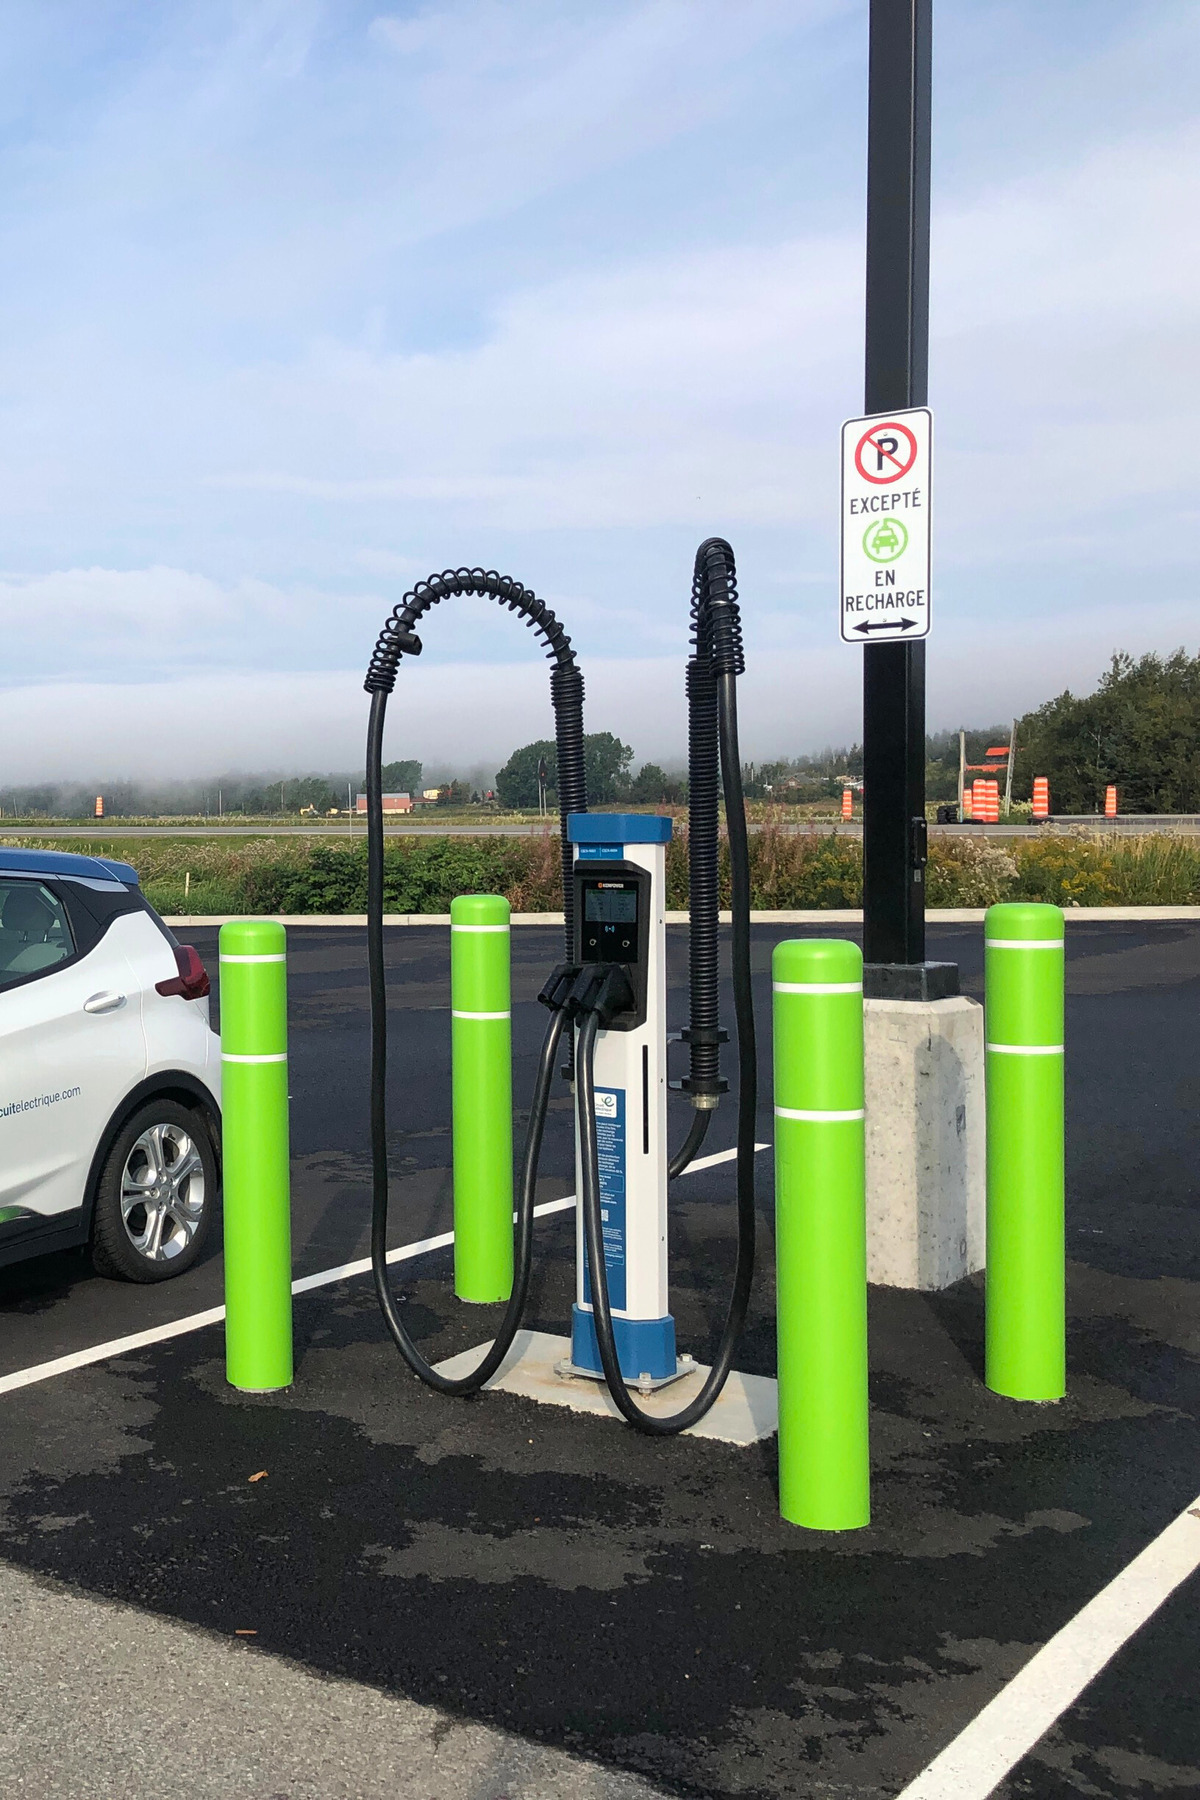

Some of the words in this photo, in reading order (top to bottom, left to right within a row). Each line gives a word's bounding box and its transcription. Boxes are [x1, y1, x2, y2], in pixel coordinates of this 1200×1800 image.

[850, 488, 922, 515] EXCEPTÉ
[875, 569, 896, 587] EN
[845, 589, 926, 612] RECHARGE
